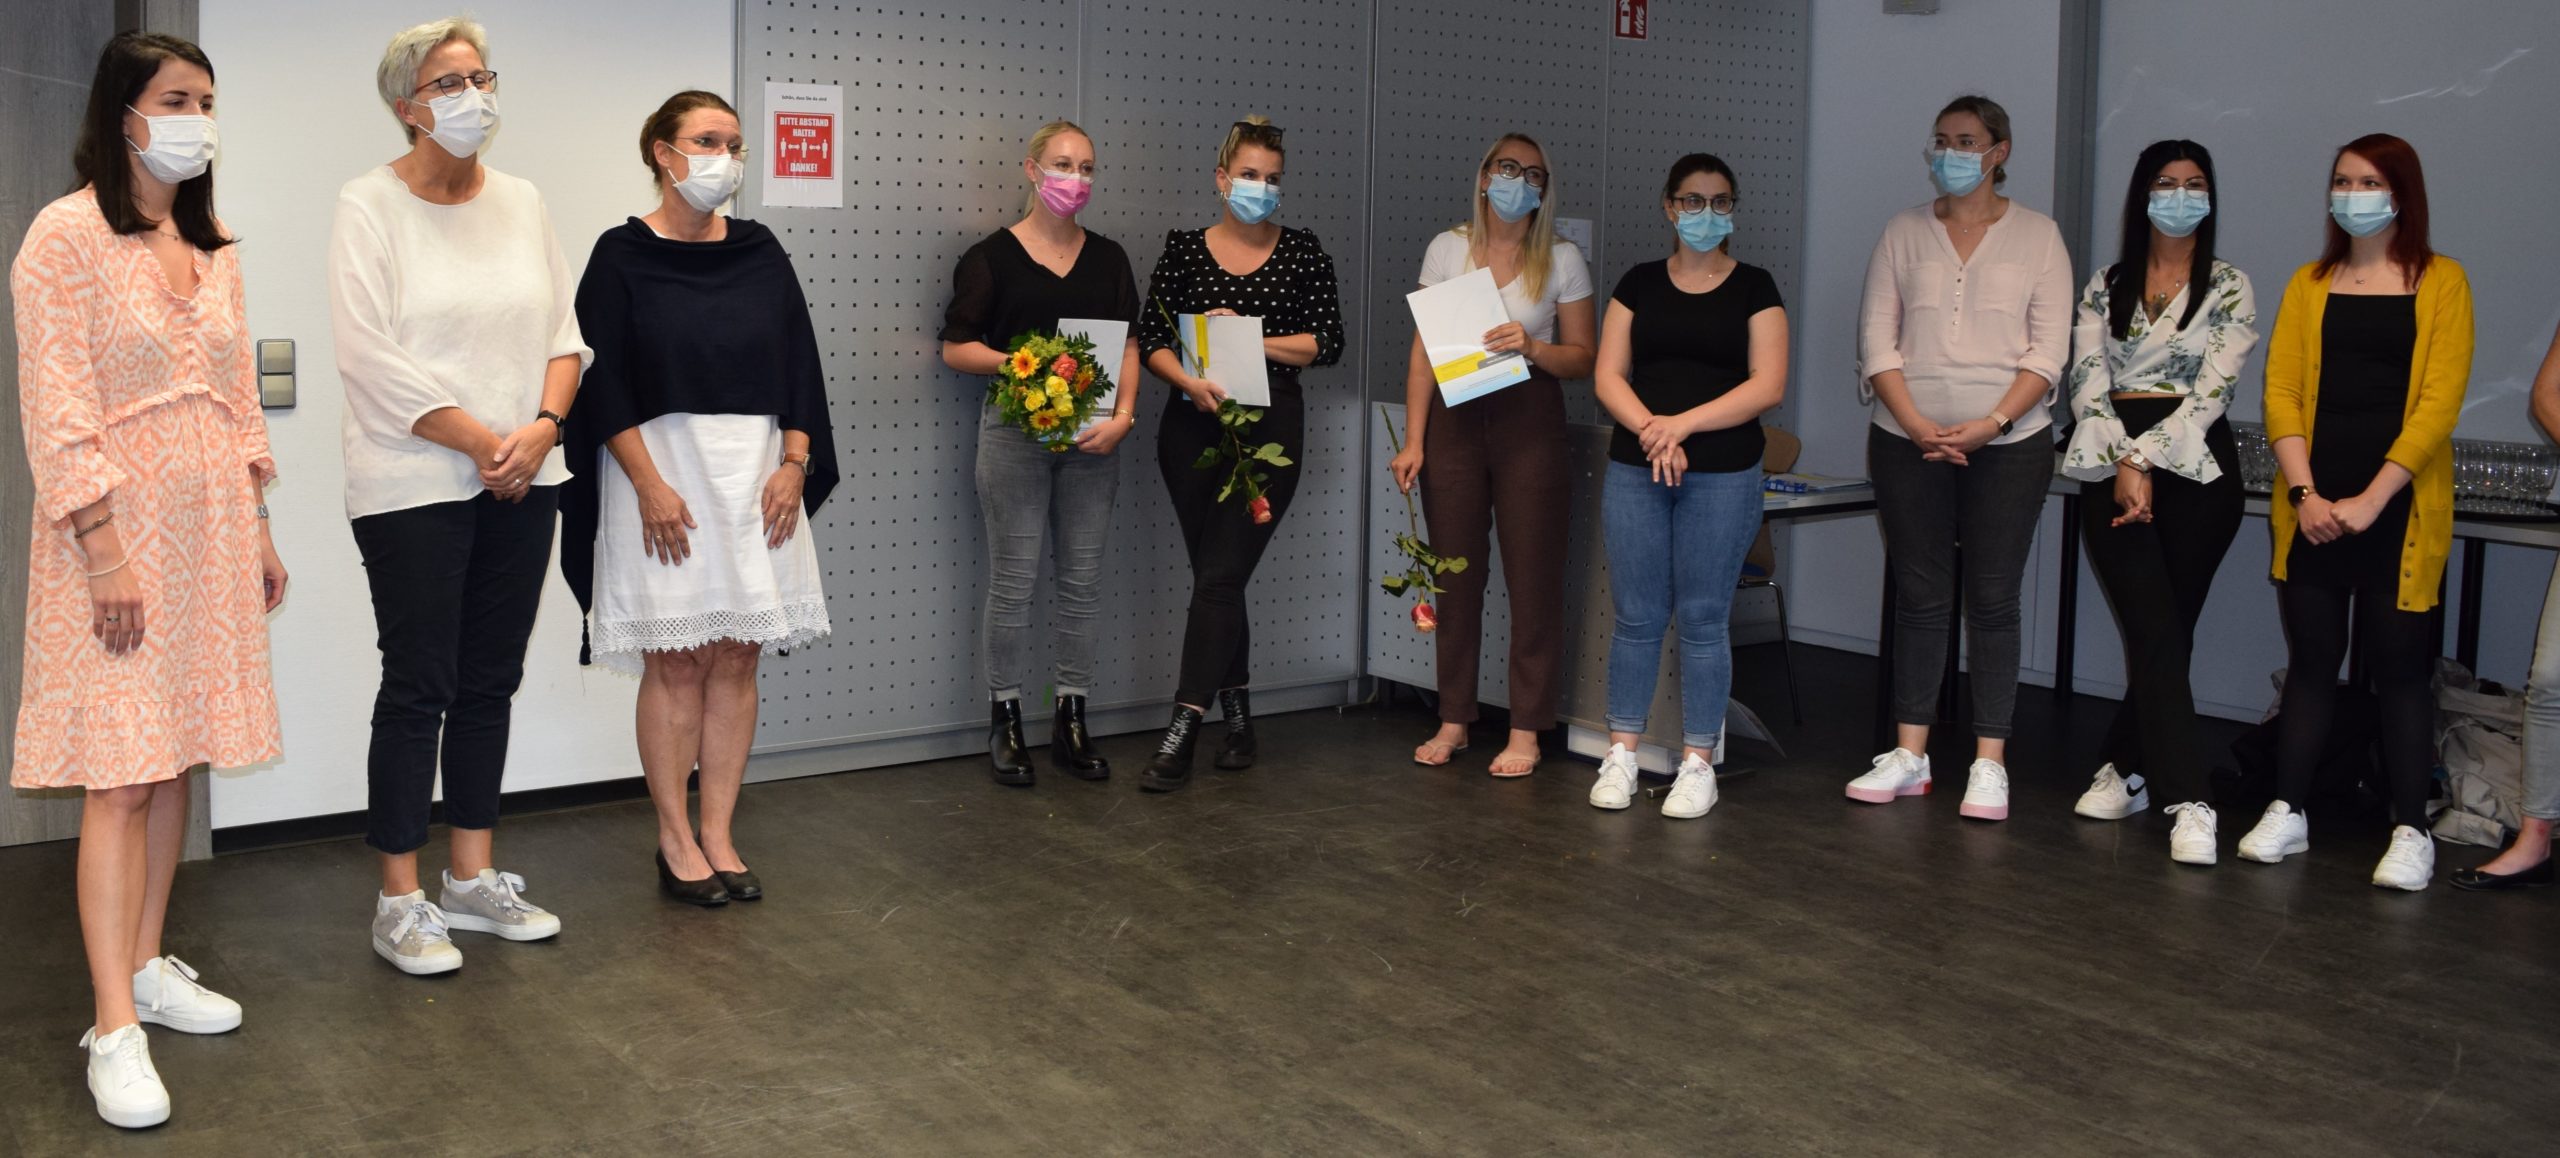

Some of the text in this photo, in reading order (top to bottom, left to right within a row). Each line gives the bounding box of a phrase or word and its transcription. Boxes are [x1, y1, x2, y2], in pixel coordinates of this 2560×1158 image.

[780, 117, 828, 127] BITTE ABSTAND
[792, 128, 816, 138] HALTEN
[790, 162, 818, 172] DANKE!
